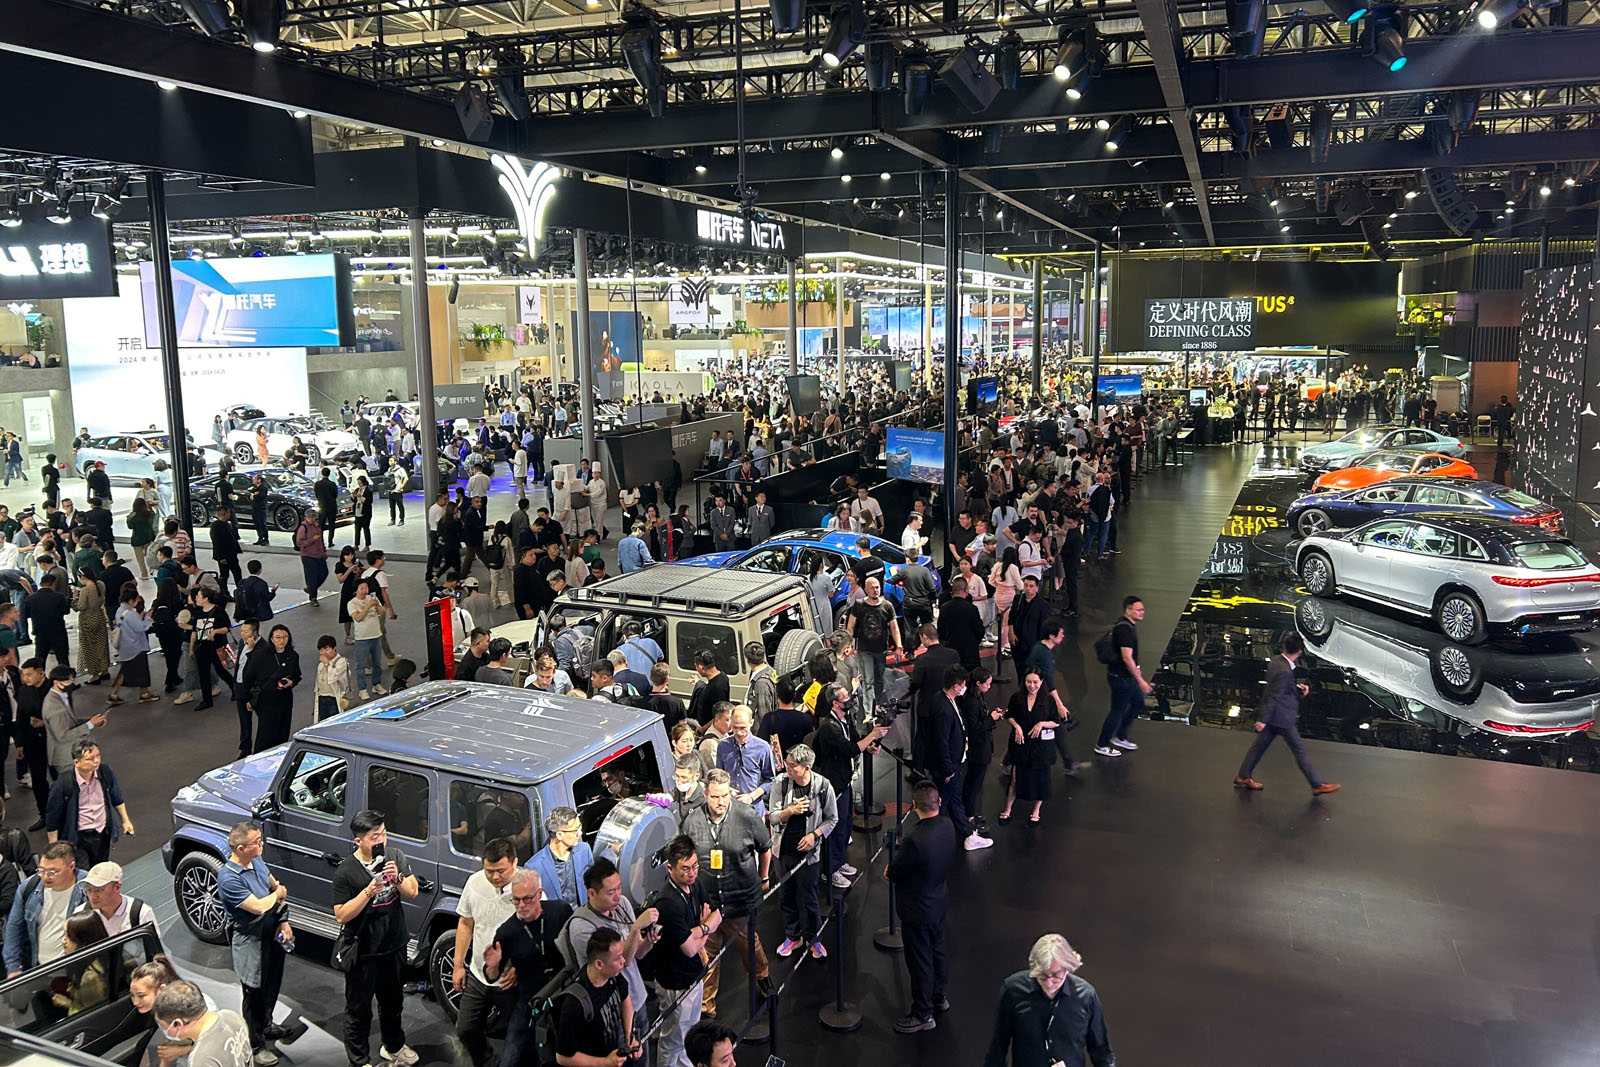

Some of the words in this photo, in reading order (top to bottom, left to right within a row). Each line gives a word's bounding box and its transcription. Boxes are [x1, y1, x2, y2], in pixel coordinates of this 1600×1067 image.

[750, 220, 785, 250] NETA
[39, 243, 91, 274] 理想
[1149, 301, 1252, 323] 定义时代风潮
[1149, 325, 1209, 338] DEFINING
[1211, 325, 1252, 338] CLASS
[118, 337, 142, 351] 开启
[1182, 342, 1200, 350] since
[1200, 342, 1218, 350] 1886
[630, 381, 684, 390] KAOLA
